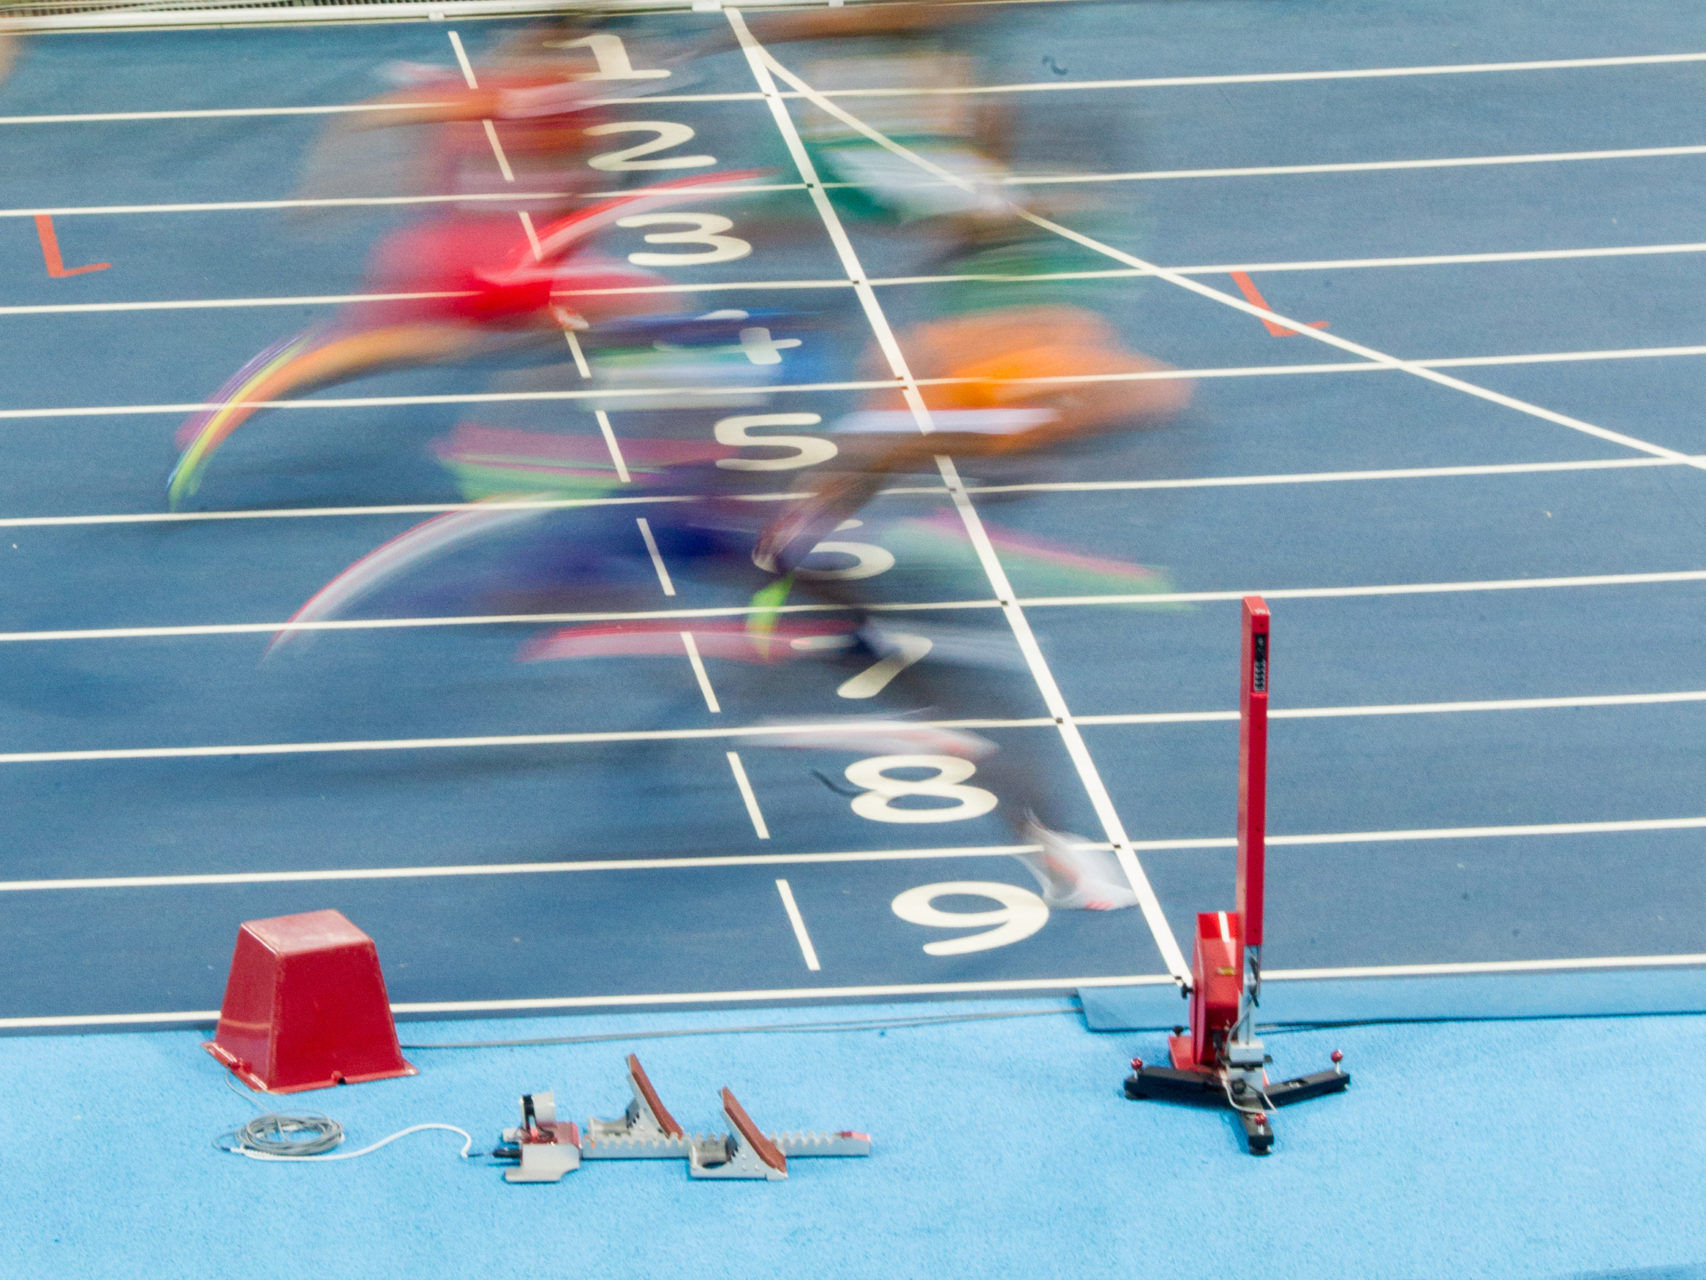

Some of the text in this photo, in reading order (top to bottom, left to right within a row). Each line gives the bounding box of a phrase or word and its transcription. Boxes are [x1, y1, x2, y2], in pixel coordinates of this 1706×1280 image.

[542, 34, 672, 81] 1
[582, 120, 718, 171] 2
[616, 212, 752, 266] 3
[714, 412, 839, 471] 5
[790, 634, 934, 699] 7
[844, 753, 999, 824] 8
[891, 880, 1050, 956] 9
